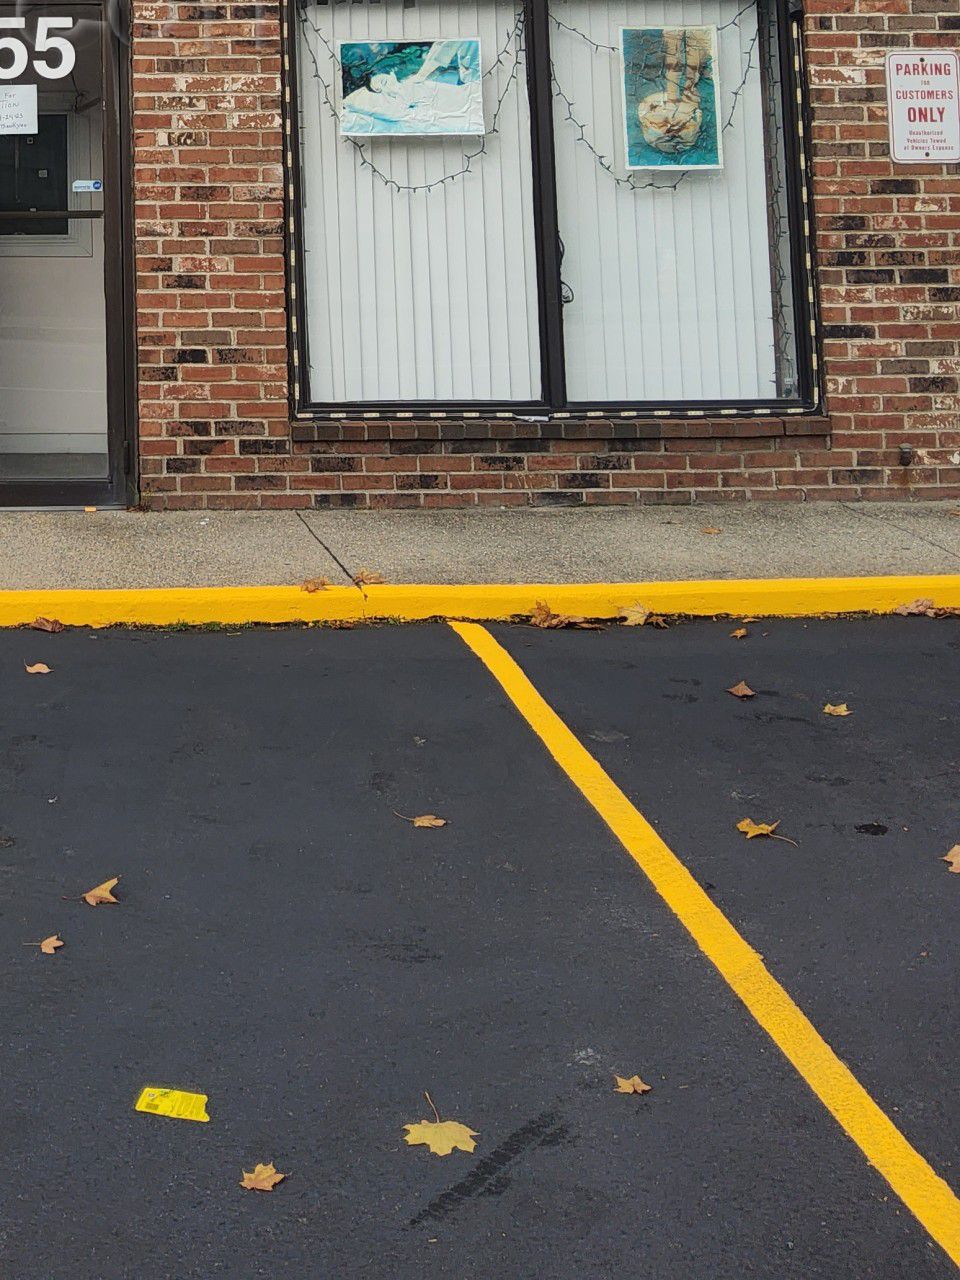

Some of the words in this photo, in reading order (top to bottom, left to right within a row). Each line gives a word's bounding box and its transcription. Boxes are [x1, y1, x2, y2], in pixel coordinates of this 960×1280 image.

[895, 63, 951, 75] PARKING
[895, 90, 954, 100] CUSTOMERS
[907, 107, 945, 123] ONLY
